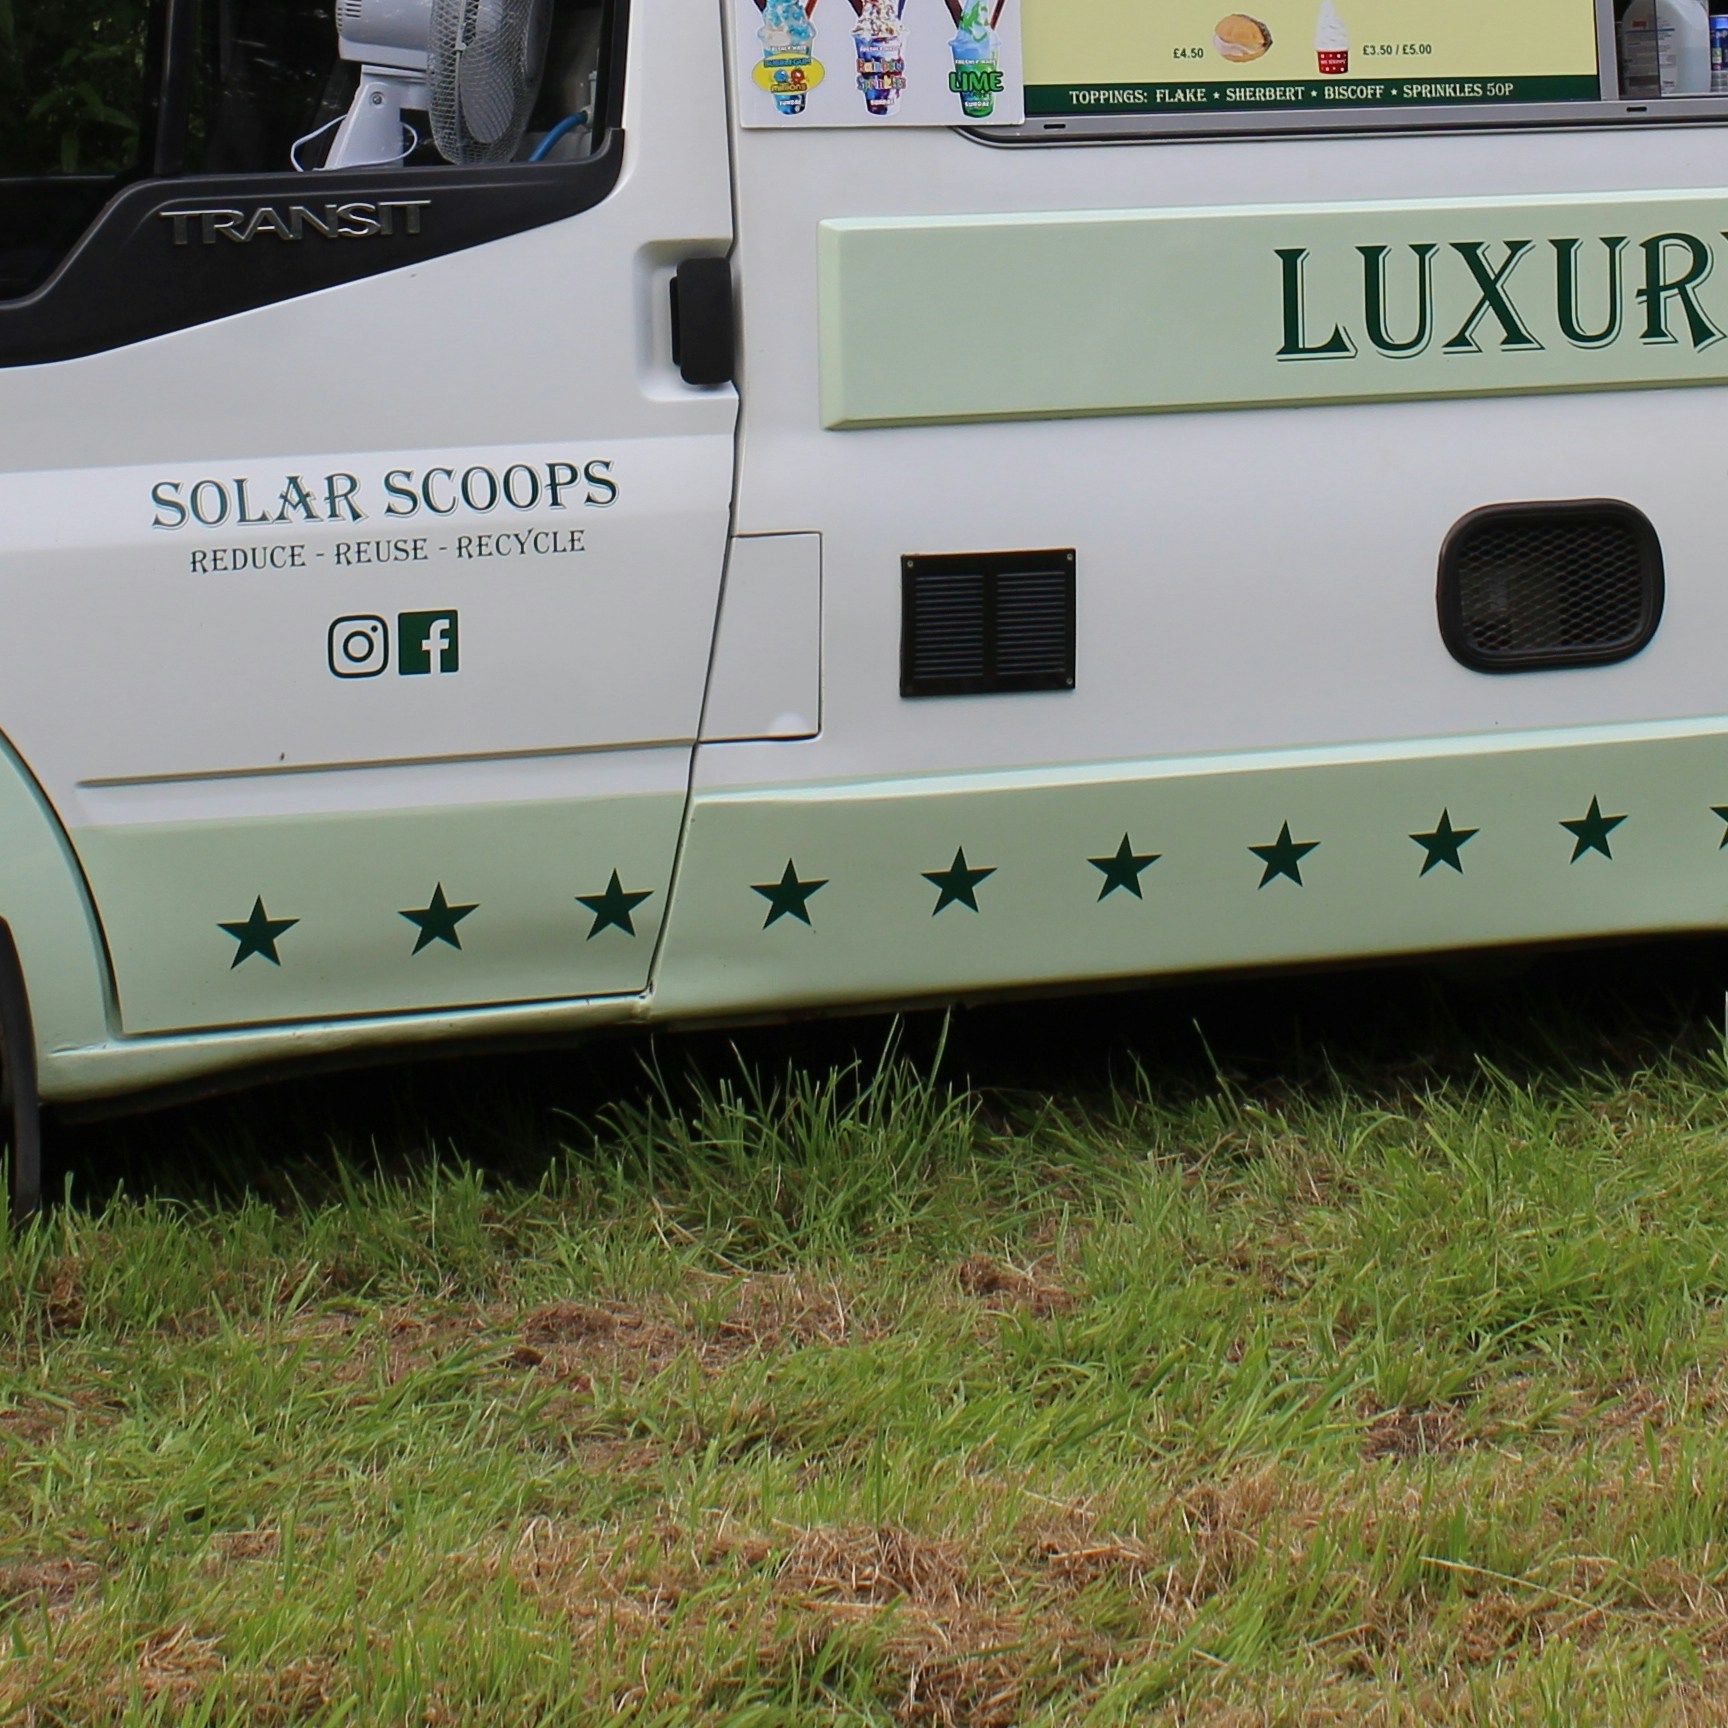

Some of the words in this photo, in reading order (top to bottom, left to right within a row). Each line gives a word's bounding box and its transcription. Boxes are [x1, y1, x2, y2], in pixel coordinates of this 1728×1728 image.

[1173, 48, 1204, 60] £4.50
[1362, 45, 1393, 56] £3.50
[1402, 44, 1432, 56] £5.00
[948, 72, 1004, 92] LIME
[1069, 89, 1149, 104] TOPPINGS:
[1156, 88, 1207, 103] FLAKE
[1226, 86, 1305, 101] SHERBERT
[1324, 85, 1385, 99] BISCOFF
[1403, 83, 1482, 98] SPRINKLES
[1486, 83, 1514, 96] 50P
[158, 199, 432, 245] TRANSIT
[150, 472, 368, 530] SOLAR
[383, 459, 621, 519] SCOOPS
[190, 544, 306, 574] REDUCE
[334, 538, 428, 567] REUSE
[456, 528, 586, 560] RECYCLE
